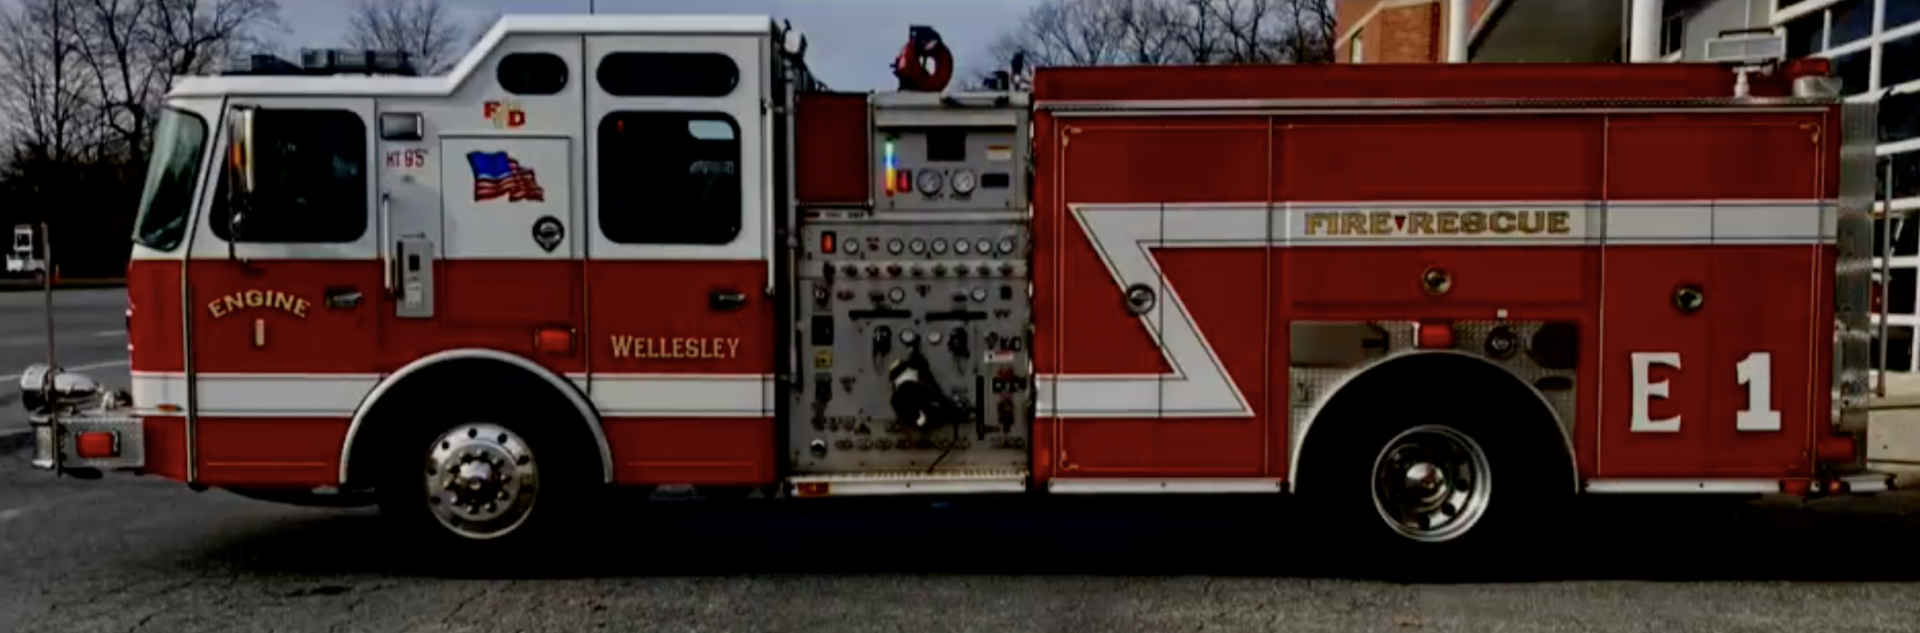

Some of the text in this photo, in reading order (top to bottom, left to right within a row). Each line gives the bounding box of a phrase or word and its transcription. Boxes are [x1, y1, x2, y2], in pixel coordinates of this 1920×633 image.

[1304, 210, 1571, 235] FIRE RESCUE
[208, 290, 311, 318] ENGINE
[610, 335, 740, 358] WELLESLEY
[1630, 352, 1781, 432] E 1
